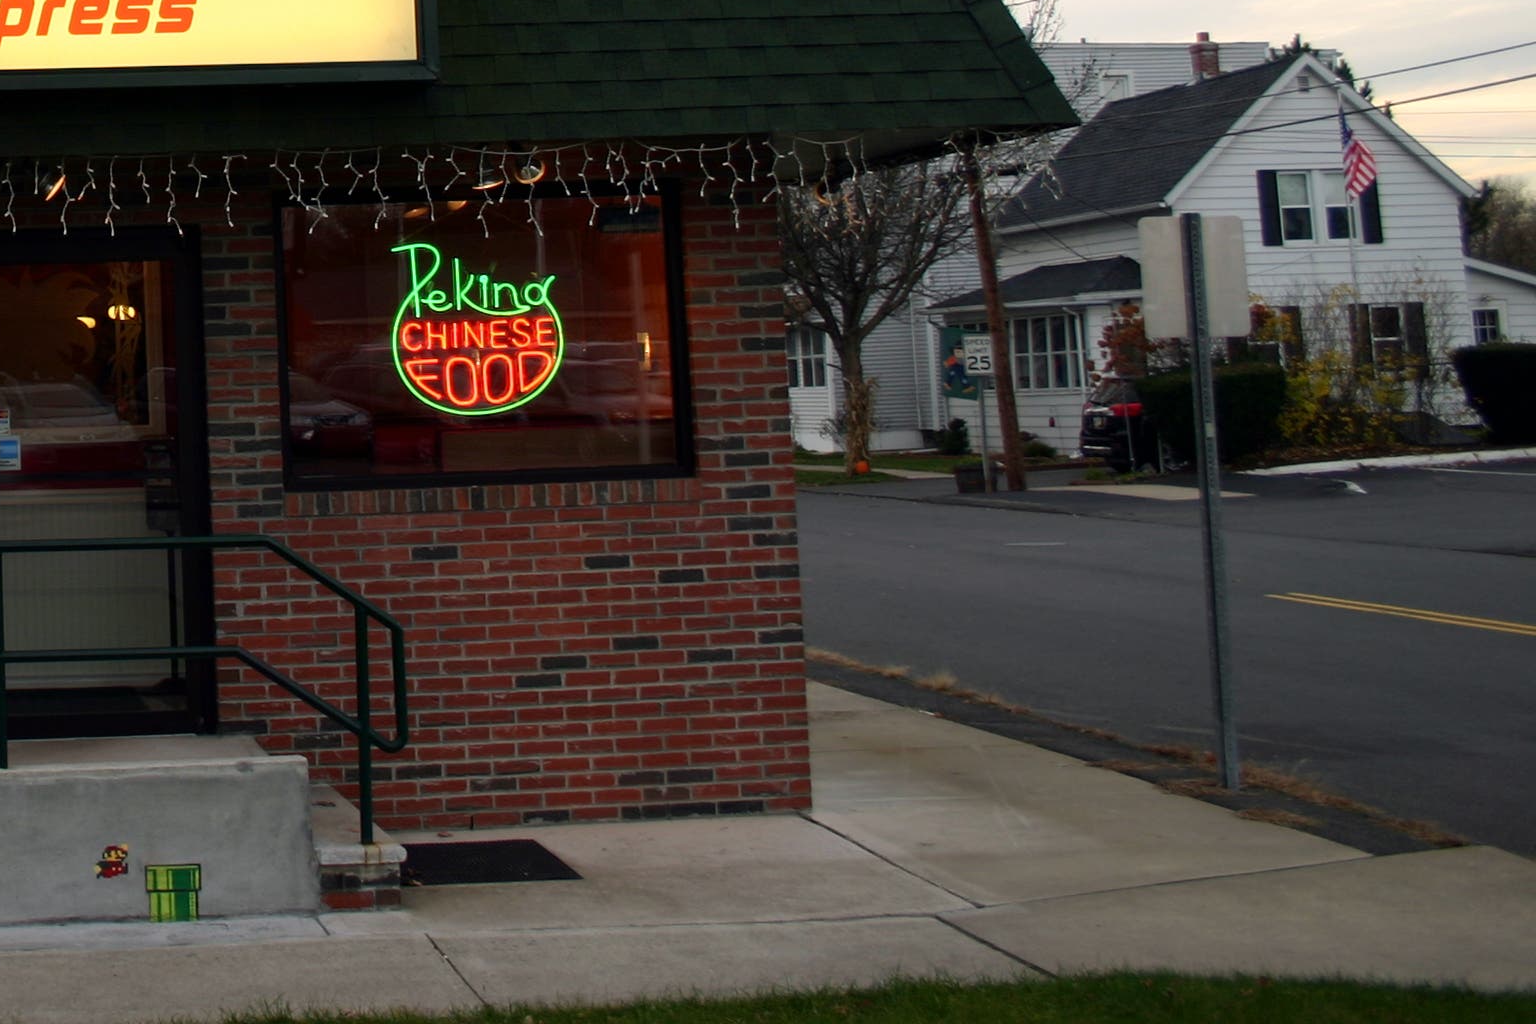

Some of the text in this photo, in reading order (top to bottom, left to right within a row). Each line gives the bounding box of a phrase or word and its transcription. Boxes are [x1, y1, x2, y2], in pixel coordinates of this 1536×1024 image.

[390, 242, 556, 318] Peking
[401, 318, 556, 351] CHINESE
[404, 351, 553, 406] FOOD
[967, 356, 992, 371] 25
